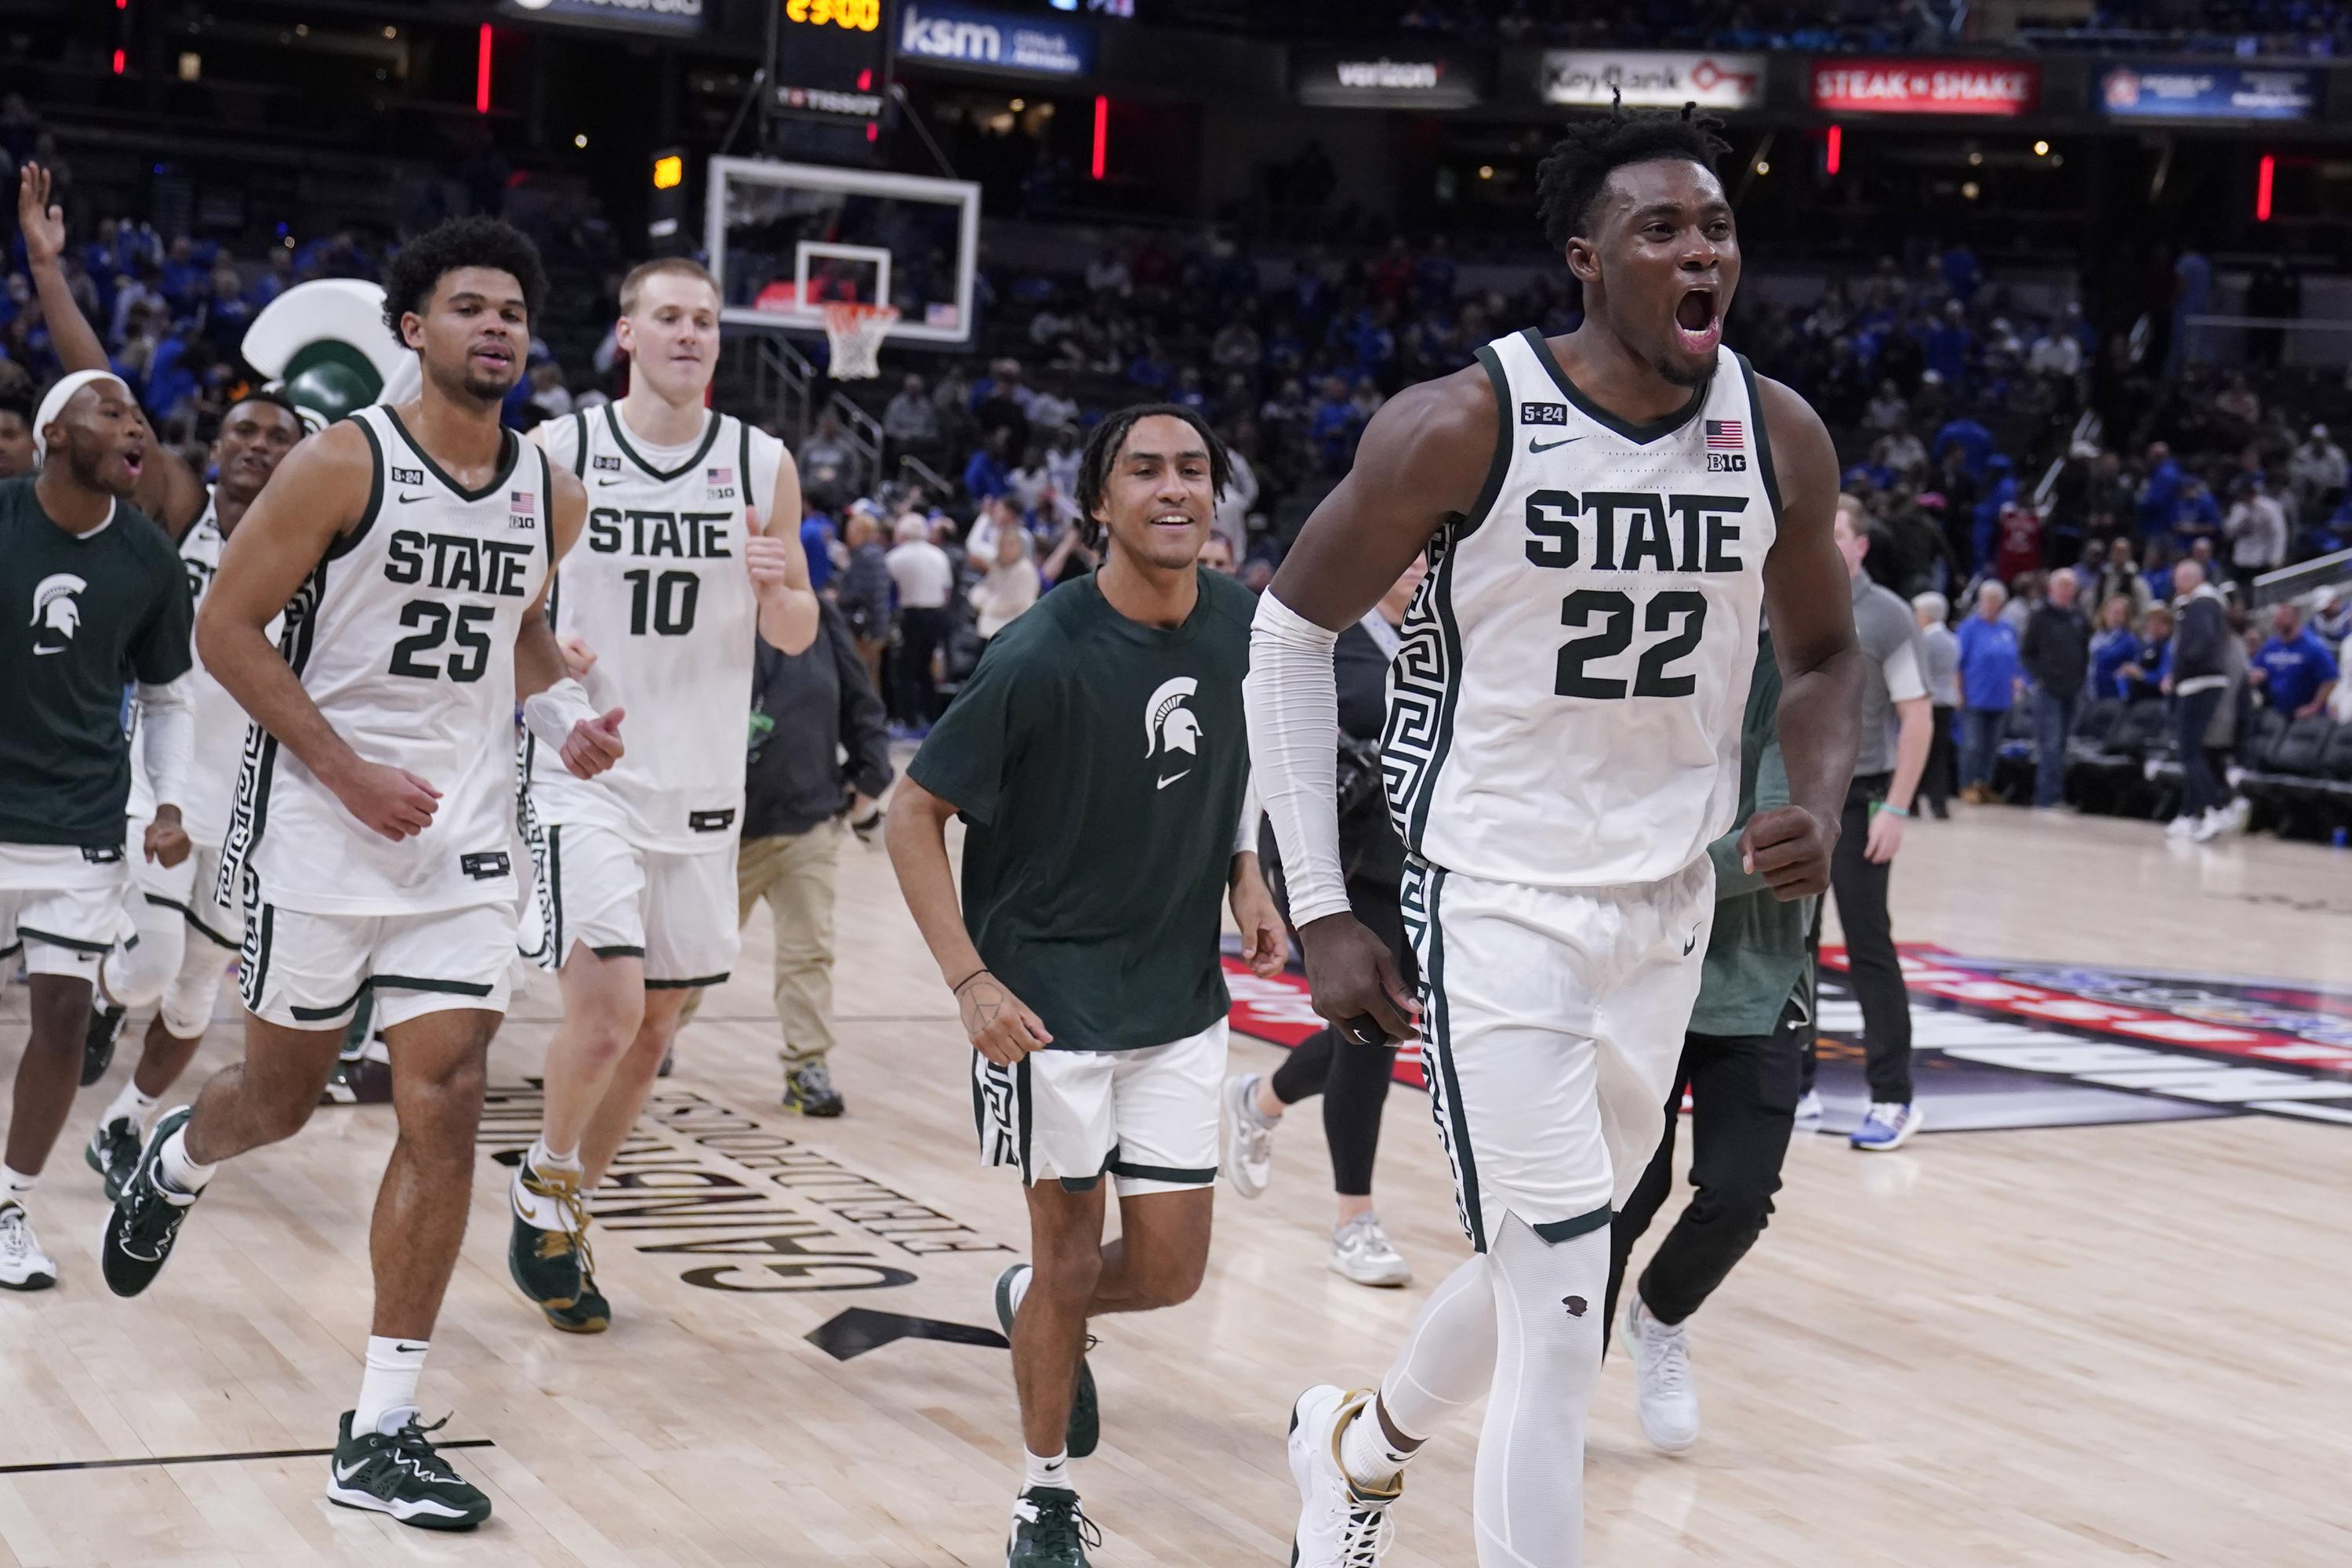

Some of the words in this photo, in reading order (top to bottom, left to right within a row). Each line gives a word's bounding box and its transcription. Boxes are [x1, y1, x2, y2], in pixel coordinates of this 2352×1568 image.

[902, 4, 1001, 61] ksm
[1337, 56, 1437, 88] verizon
[1816, 70, 1907, 99] STEAK
[383, 529, 535, 597] STATE
[590, 506, 733, 558] STATE
[1526, 489, 1749, 572] STATE
[623, 569, 700, 636] 10
[388, 599, 495, 682] 25
[1555, 589, 1708, 699] 22
